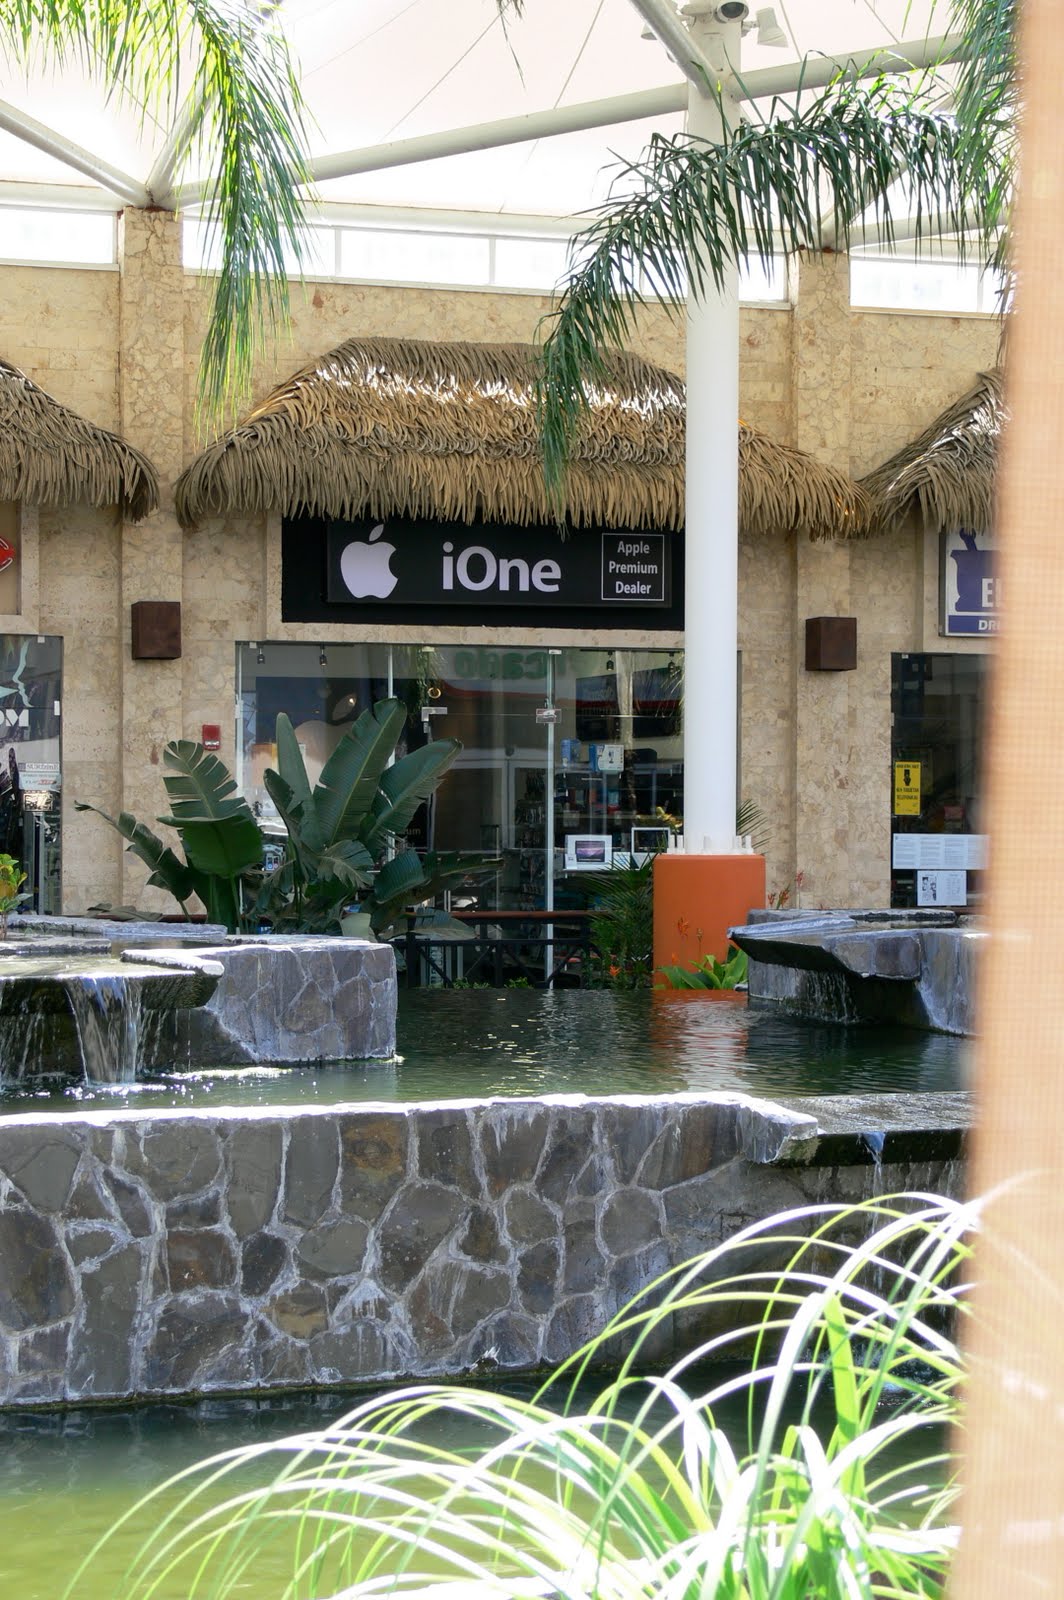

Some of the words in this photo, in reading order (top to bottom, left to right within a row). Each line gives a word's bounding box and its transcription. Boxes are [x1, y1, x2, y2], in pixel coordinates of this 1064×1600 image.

[618, 541, 650, 558] Apple
[443, 542, 561, 593] iOne
[609, 562, 658, 575] Premium
[616, 581, 651, 595] Dealer
